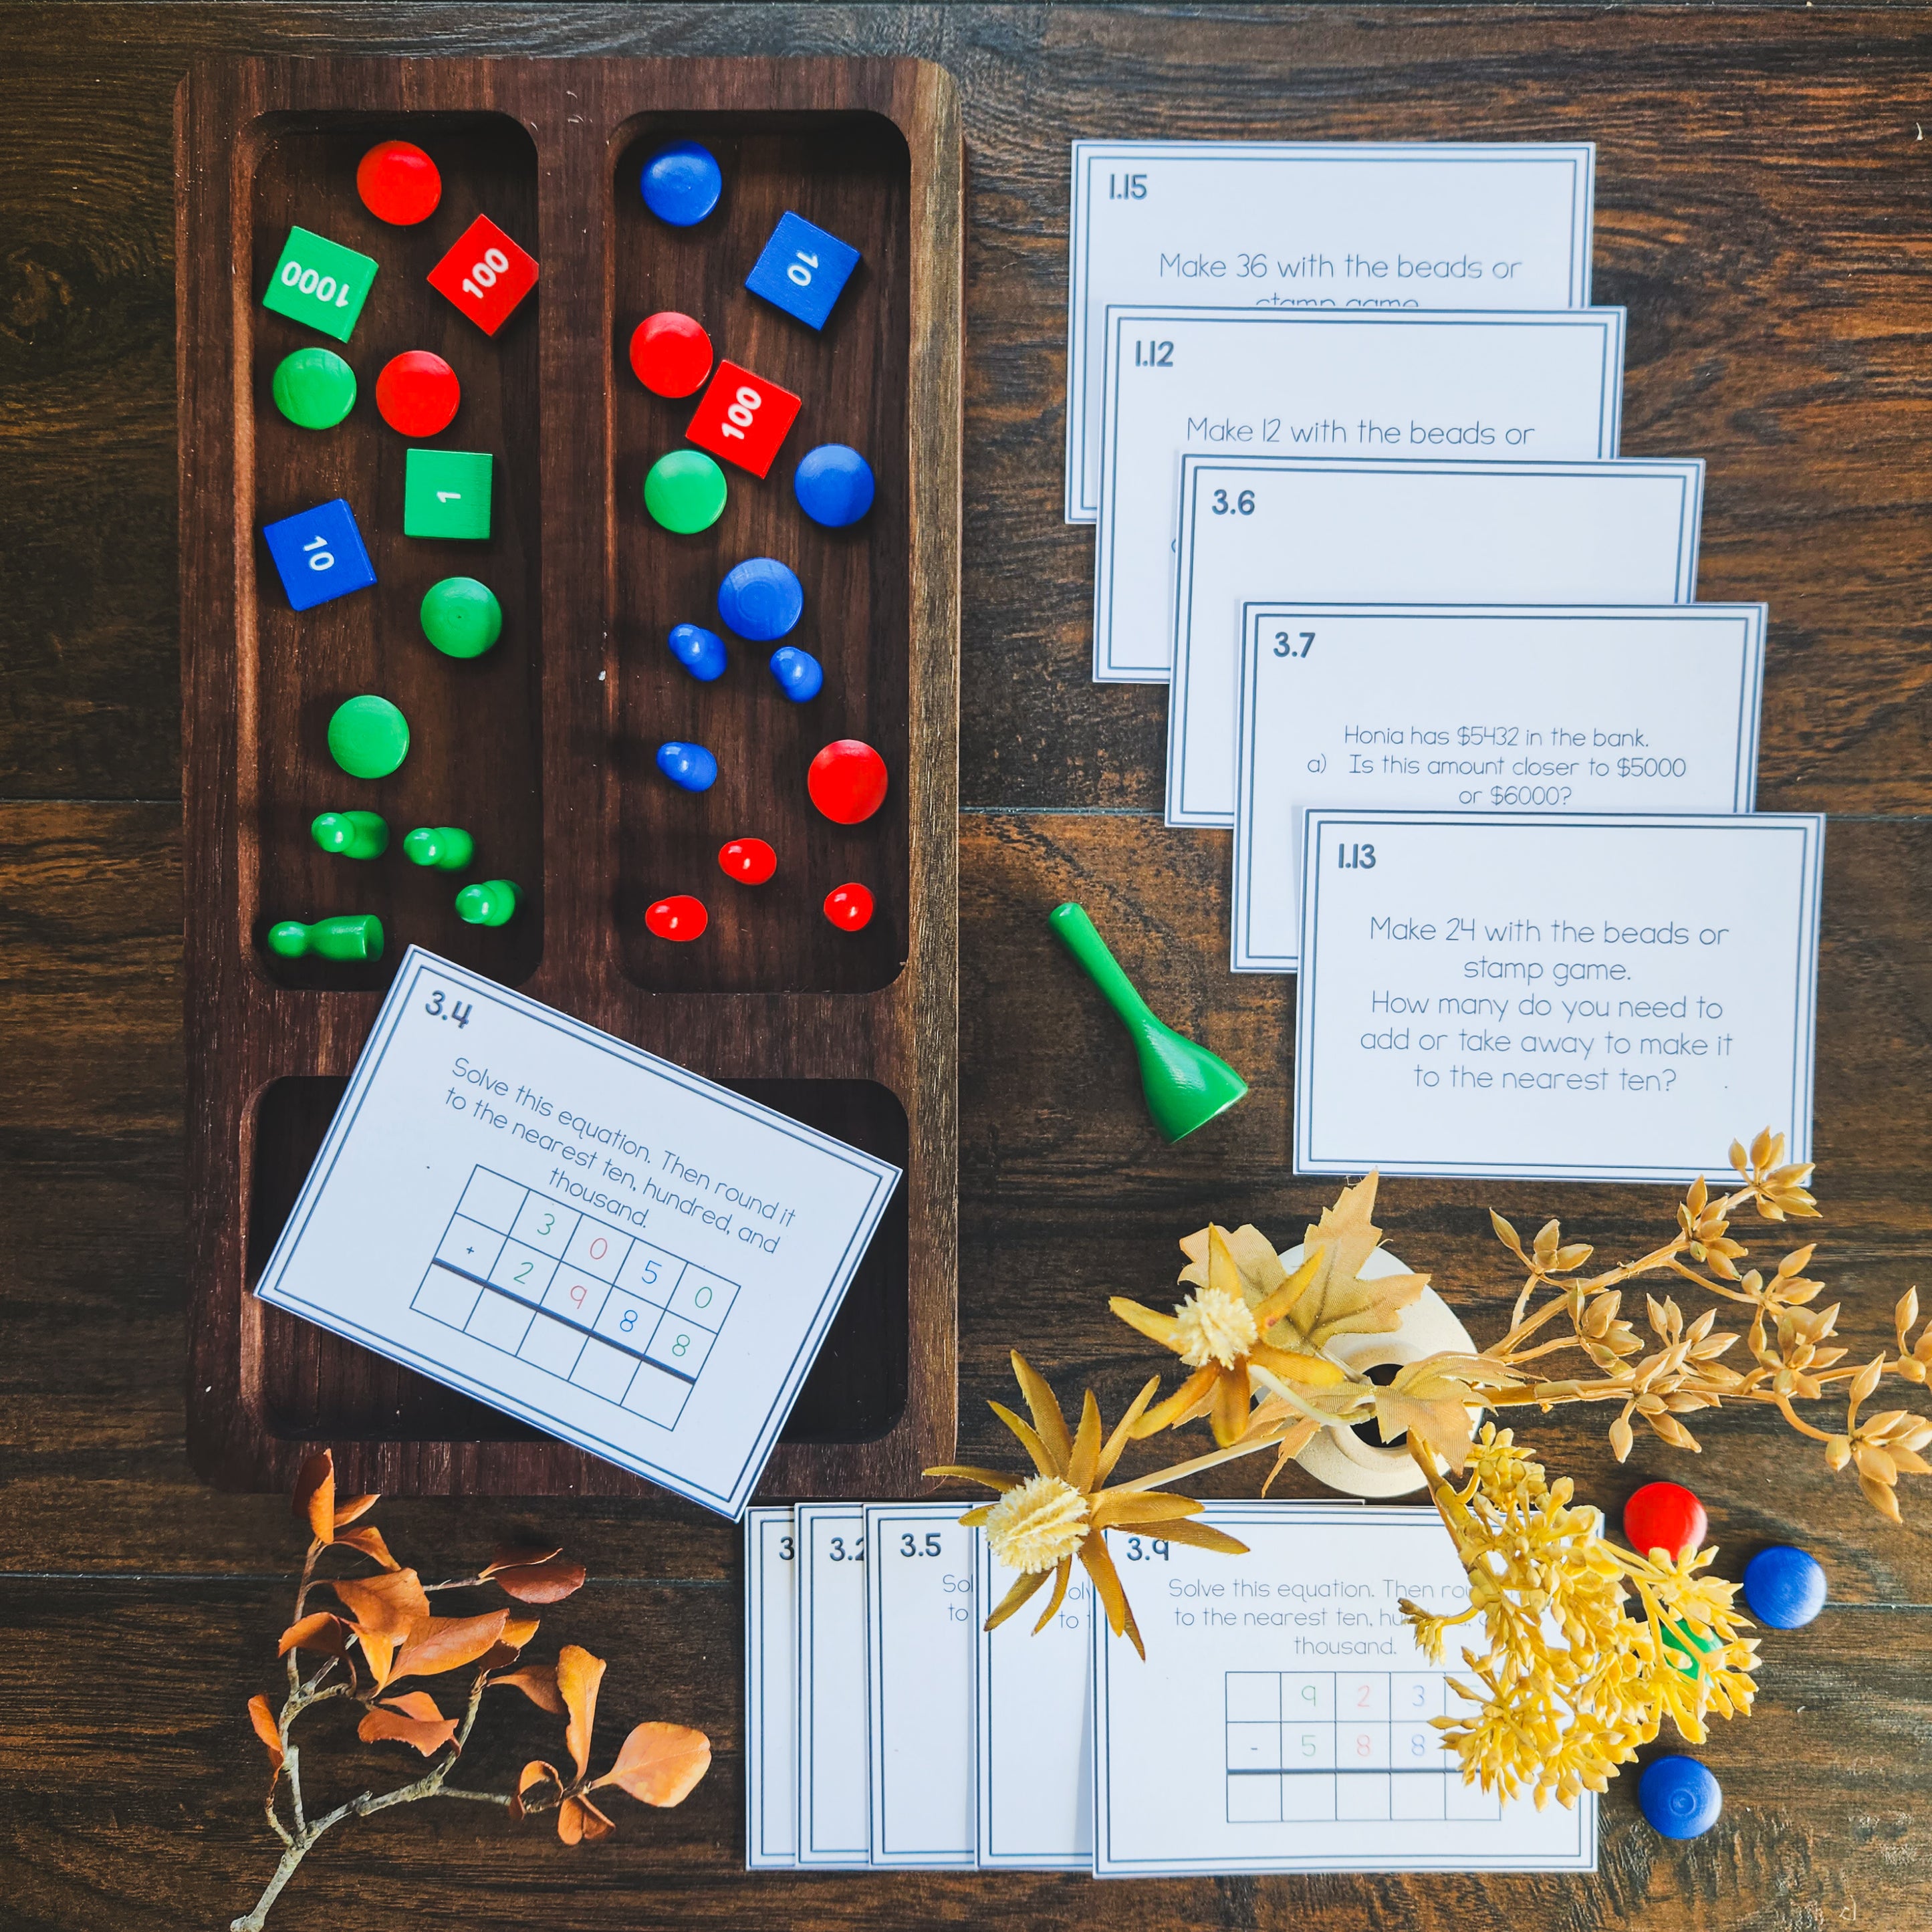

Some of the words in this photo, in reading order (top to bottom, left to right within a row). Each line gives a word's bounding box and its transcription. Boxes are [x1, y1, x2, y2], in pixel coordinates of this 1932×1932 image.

[1110, 174, 1147, 200] 1.15
[463, 249, 508, 298] 100
[788, 253, 818, 286] 10
[1161, 253, 1226, 277] Make
[1237, 254, 1267, 277] 36
[1278, 254, 1333, 277] with
[1345, 254, 1388, 277] the
[1398, 254, 1481, 278] beads
[1493, 262, 1522, 279] or
[281, 260, 349, 307] 1000
[1136, 340, 1174, 367] 1.12
[722, 387, 761, 439] 100
[1188, 418, 1253, 441] Make
[1263, 418, 1280, 442] 12
[1291, 420, 1346, 443] with
[1358, 420, 1401, 443] the
[1411, 420, 1495, 445] beads
[1505, 429, 1535, 445] or
[437, 492, 461, 503] 1
[1212, 489, 1255, 515] 3.6
[304, 537, 334, 570] 10
[1274, 632, 1316, 658] 3.7
[1345, 725, 1403, 744] Honia
[1411, 727, 1449, 745] has
[1457, 726, 1518, 746] $5432
[1527, 730, 1542, 745] in
[1552, 728, 1586, 746] the
[1594, 729, 1648, 747] bank.
[1308, 753, 1326, 773] a)
[1350, 755, 1373, 773] Is
[1383, 755, 1419, 773] this
[1428, 757, 1504, 774] amount
[1513, 757, 1579, 775] closer
[1589, 758, 1609, 776] to
[1617, 757, 1686, 777] $5000
[1459, 791, 1482, 804] or
[1491, 786, 1571, 806] $6000?
[1338, 844, 1376, 869] 1.13
[1371, 917, 1436, 940] Make
[1446, 918, 1474, 941] 24
[1485, 919, 1540, 941] with
[1551, 920, 1594, 943] the
[1604, 921, 1689, 944] beads
[1699, 929, 1729, 945] or
[1465, 956, 1543, 985] stamp
[1553, 963, 1631, 987] game.
[425, 990, 473, 1030] 3.4
[1372, 991, 1429, 1013] How
[1439, 998, 1508, 1021] many
[1519, 993, 1551, 1015] do
[1562, 1001, 1609, 1023] you
[1619, 996, 1686, 1017] need
[1697, 996, 1722, 1019] to
[1361, 1028, 1409, 1050] add
[1419, 1034, 1447, 1050] or
[1459, 1029, 1510, 1052] take
[1521, 1036, 1594, 1060] away
[1605, 1032, 1631, 1054] to
[1641, 1033, 1708, 1055] make
[1718, 1034, 1733, 1056] it
[1414, 1064, 1439, 1087] to
[1450, 1065, 1493, 1088] the
[1503, 1068, 1608, 1090] nearest
[1619, 1068, 1676, 1091] ten?
[452, 1057, 509, 1096] Solve
[515, 1085, 554, 1116] this
[558, 1110, 650, 1164] equation.
[662, 1150, 710, 1190] Then
[714, 1182, 779, 1220] round
[779, 1209, 796, 1227] it
[445, 1087, 467, 1110] to
[473, 1100, 508, 1128] the
[511, 1122, 598, 1169] nearest
[602, 1159, 636, 1192] ten,
[642, 1177, 733, 1235] hundred,
[738, 1227, 781, 1253] and
[549, 1167, 649, 1228] thousand.
[537, 1213, 556, 1235] 3
[590, 1237, 608, 1260] 0
[641, 1259, 662, 1284] 5
[695, 1286, 713, 1309] 0
[513, 1261, 534, 1284] 2
[619, 1309, 638, 1332] 8
[671, 1334, 691, 1357] 8
[900, 1532, 941, 1557] 3.5
[1126, 1536, 1169, 1561] 3.9
[1169, 1579, 1224, 1597] Solve
[1233, 1579, 1270, 1597] this
[1278, 1580, 1374, 1602] equation.
[1383, 1580, 1434, 1598] Then
[947, 1602, 968, 1621] to
[1058, 1610, 1079, 1628] to
[1175, 1608, 1194, 1625] to
[1203, 1608, 1236, 1625] the
[1245, 1608, 1327, 1625] nearest
[1337, 1608, 1372, 1626] ten,
[1294, 1637, 1396, 1655] thousand.
[1302, 1685, 1316, 1706] 9
[1357, 1685, 1370, 1707] 2
[1413, 1685, 1425, 1706] 3
[1302, 1735, 1316, 1756] 5
[1357, 1735, 1370, 1756] 8
[1412, 1735, 1425, 1756] 8
